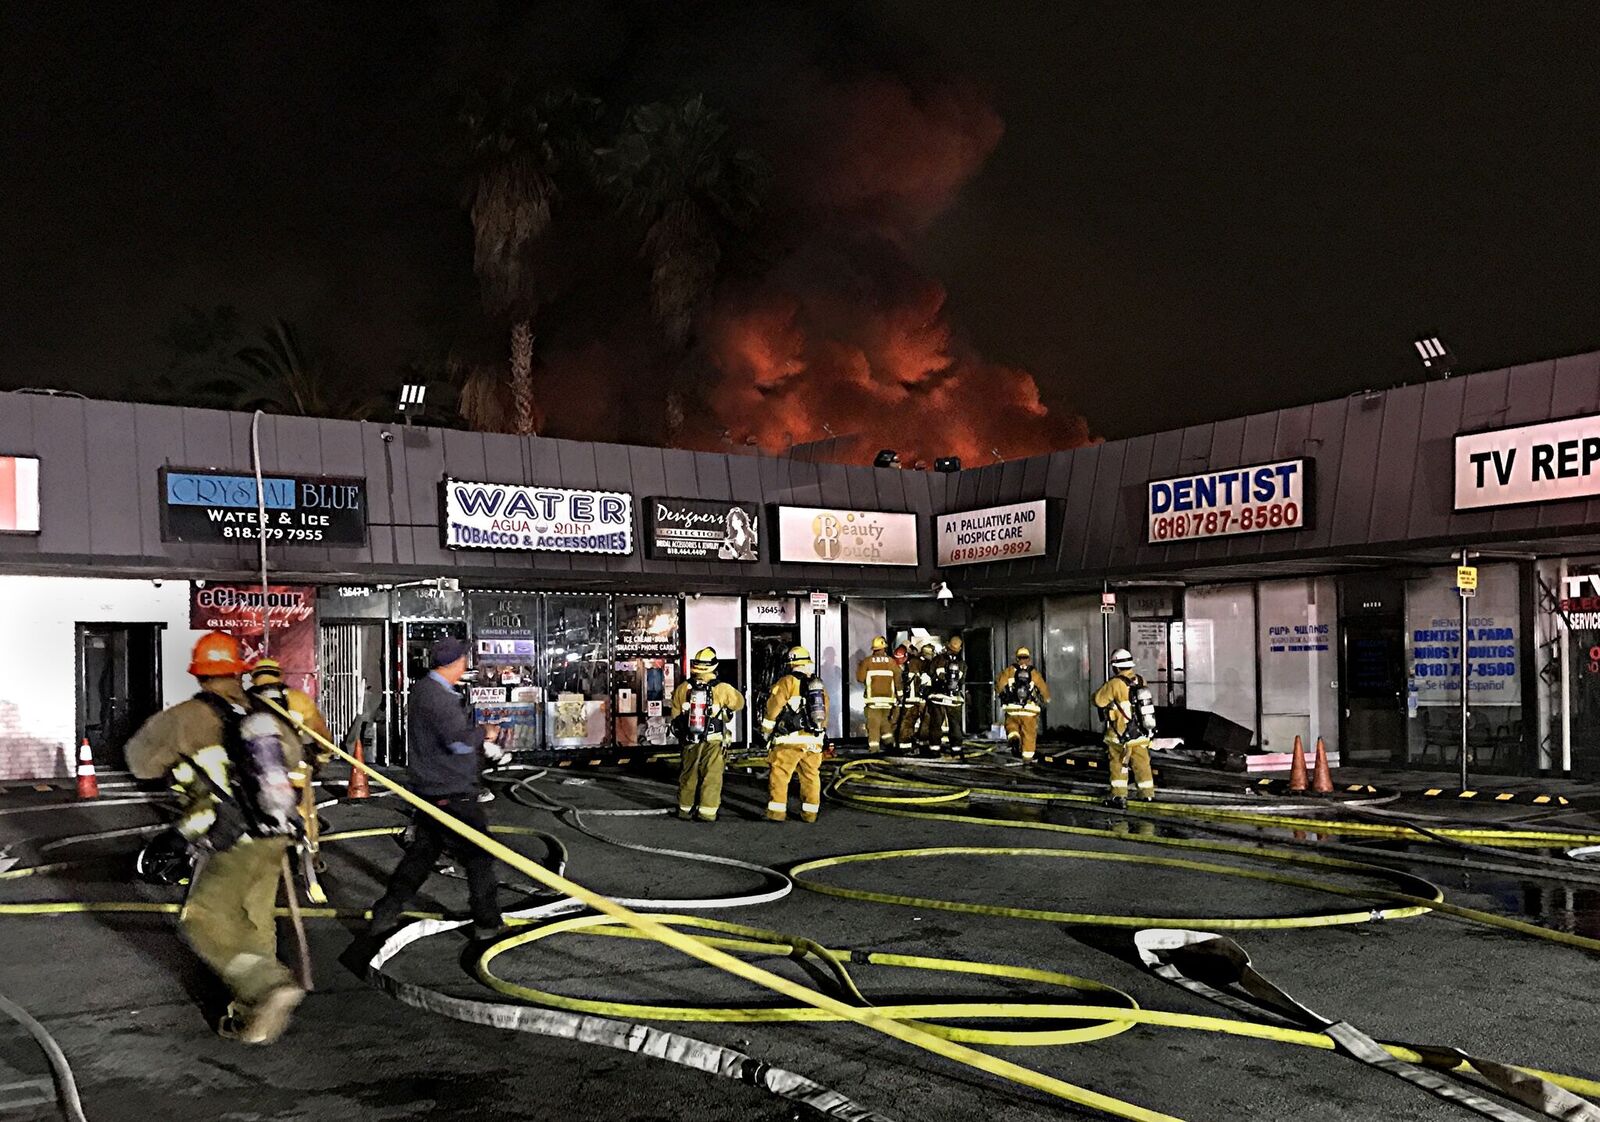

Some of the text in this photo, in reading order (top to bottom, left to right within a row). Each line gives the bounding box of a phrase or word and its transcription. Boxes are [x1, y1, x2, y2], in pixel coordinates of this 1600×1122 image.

[1470, 437, 1600, 488] TV REP
[302, 484, 359, 510] BLUE
[1152, 464, 1297, 514] DENTIST
[455, 486, 626, 525] WATER
[207, 509, 330, 526] WATER & ICE
[491, 519, 531, 532] AGUA
[945, 510, 1035, 533] A1 PALLIATIVE AND
[288, 529, 323, 541] 7955
[452, 521, 626, 550] TOBACCO & ACCESSORIES
[820, 516, 884, 540] Beauty
[957, 526, 1022, 545] HOSPICE CARE
[950, 541, 1032, 561] (818)390-9892
[198, 588, 303, 608] eGlamour
[757, 606, 785, 614] 13645-A
[1432, 617, 1494, 627] BIENVNIDOS
[1414, 628, 1513, 642] DENTISA PARA
[1464, 645, 1515, 658] DULTOS
[1450, 662, 1515, 676] 77-8580
[471, 688, 505, 697] WATER
[1439, 680, 1464, 690] Habl
